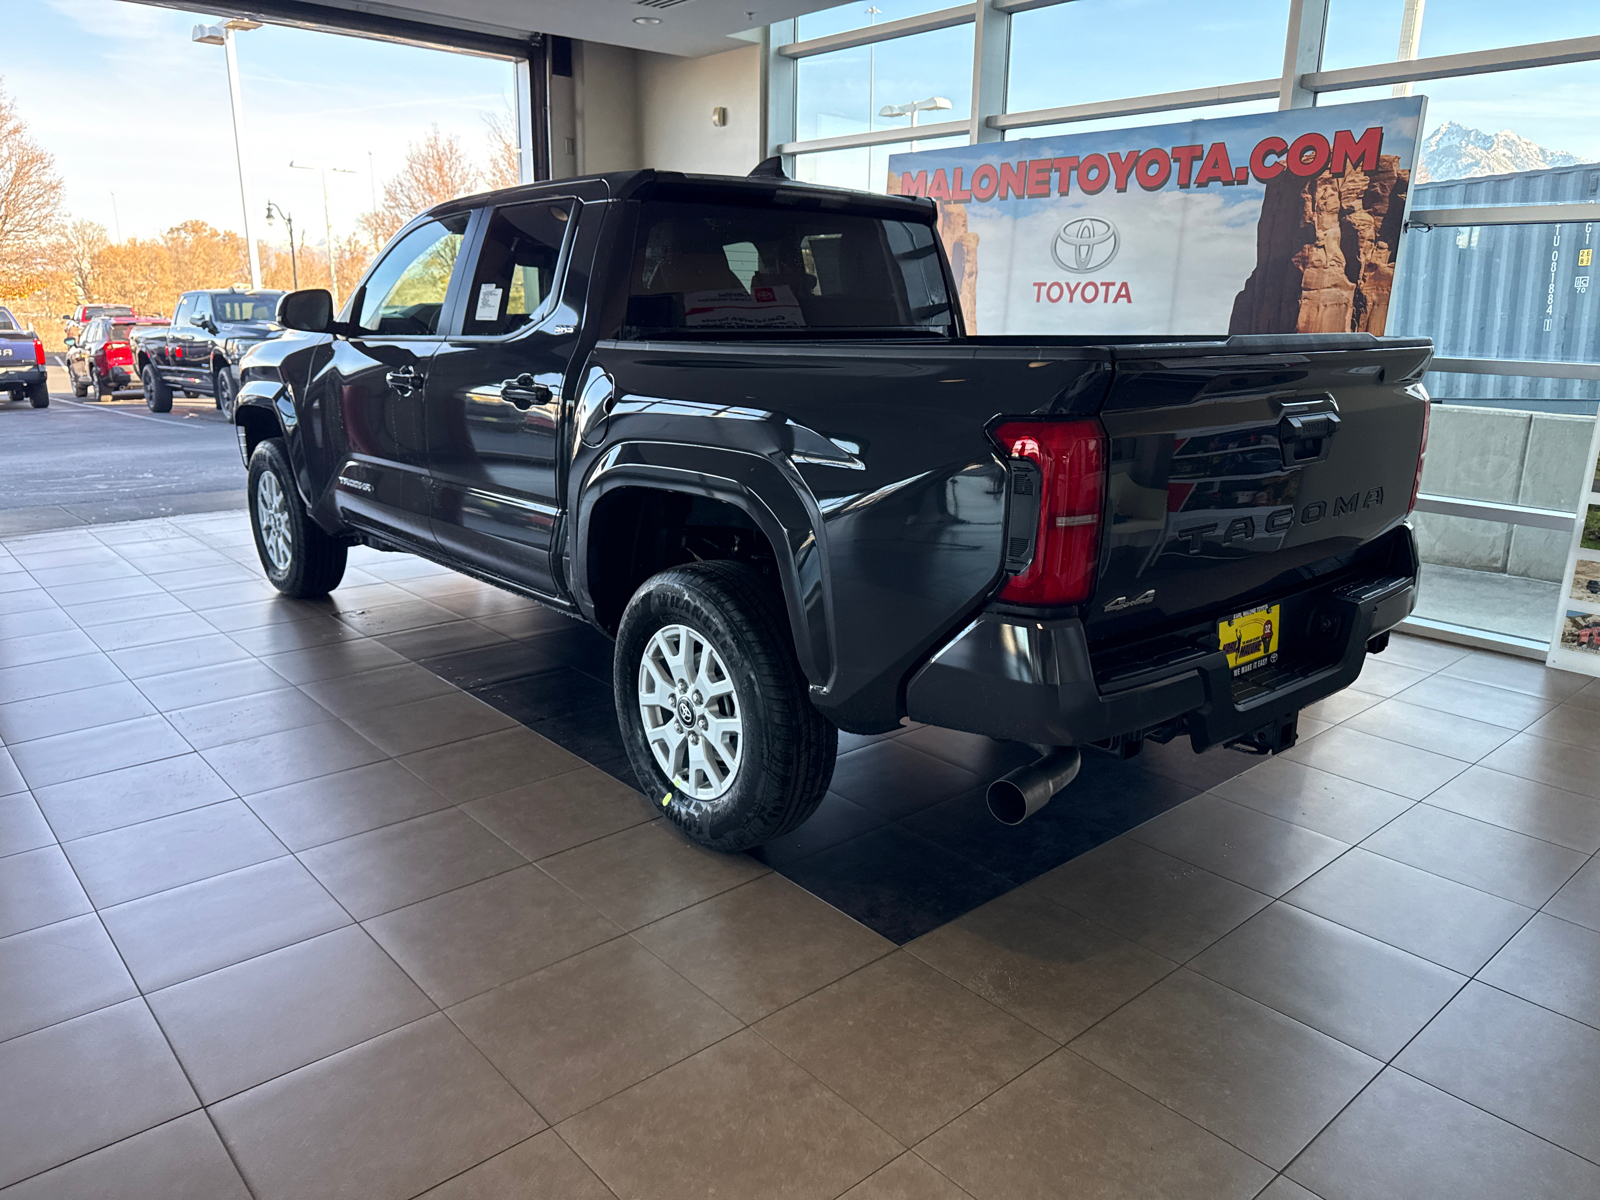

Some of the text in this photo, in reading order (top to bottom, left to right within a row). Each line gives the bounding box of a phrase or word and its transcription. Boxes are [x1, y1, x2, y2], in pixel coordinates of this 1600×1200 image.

[901, 126, 1383, 204] MALONETOYOTA.COM
[1033, 281, 1132, 304] TOYOTA
[1178, 486, 1385, 554] TACOMA
